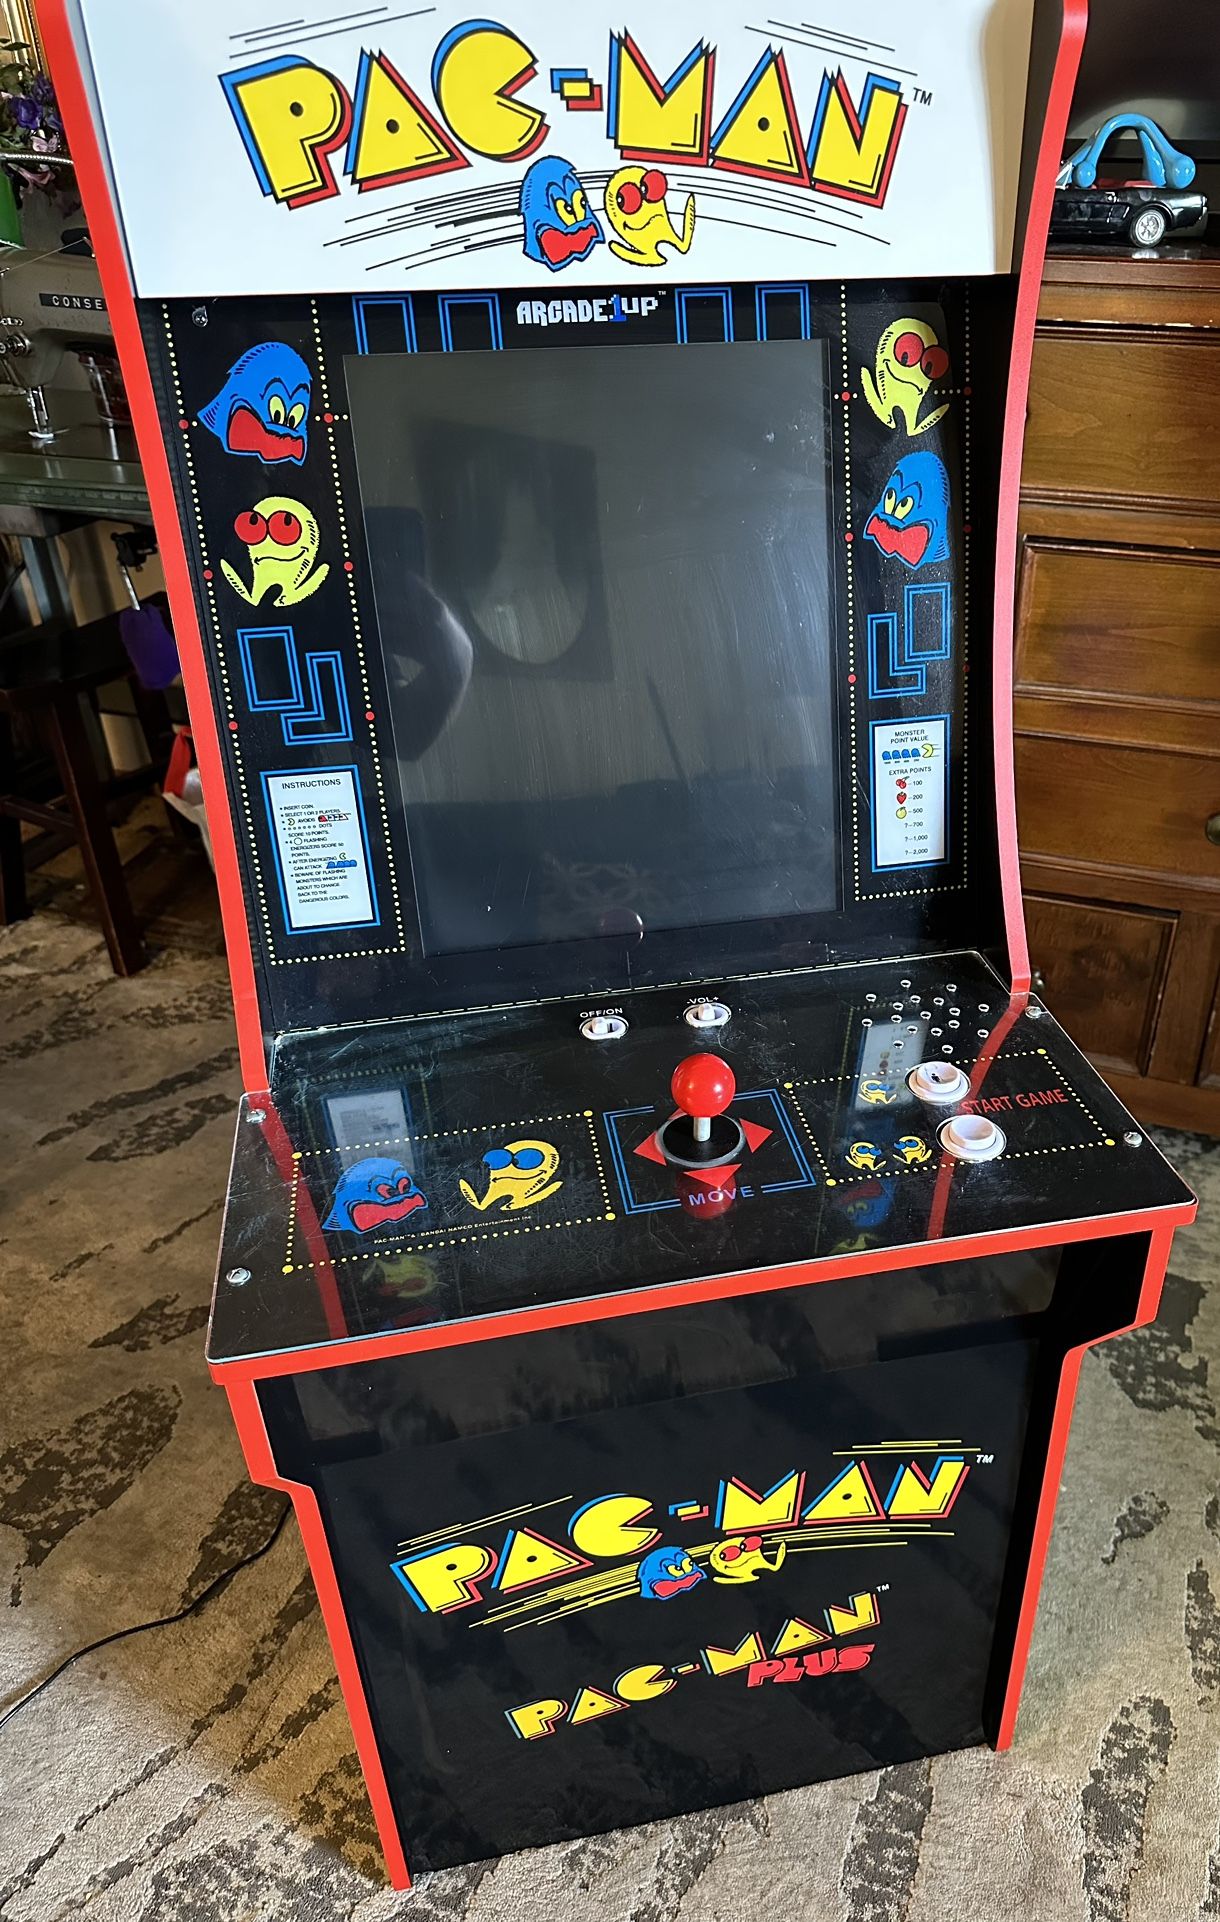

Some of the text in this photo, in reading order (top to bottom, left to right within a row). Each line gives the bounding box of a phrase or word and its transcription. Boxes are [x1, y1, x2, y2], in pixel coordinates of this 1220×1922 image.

[218, 18, 910, 210] PAC-MAN
[282, 779, 341, 790] INSTRUCTIONS
[580, 1008, 624, 1018] OFF/ON
[960, 1088, 1068, 1114] START GAME
[688, 1186, 754, 1206] MOVE
[448, 1224, 472, 1232] NAMCO
[474, 1217, 520, 1228] Entertainment
[389, 1456, 971, 1614] PAC-MAN
[504, 1591, 881, 1740] PAC-MAN
[747, 1643, 875, 1688] PLUS
